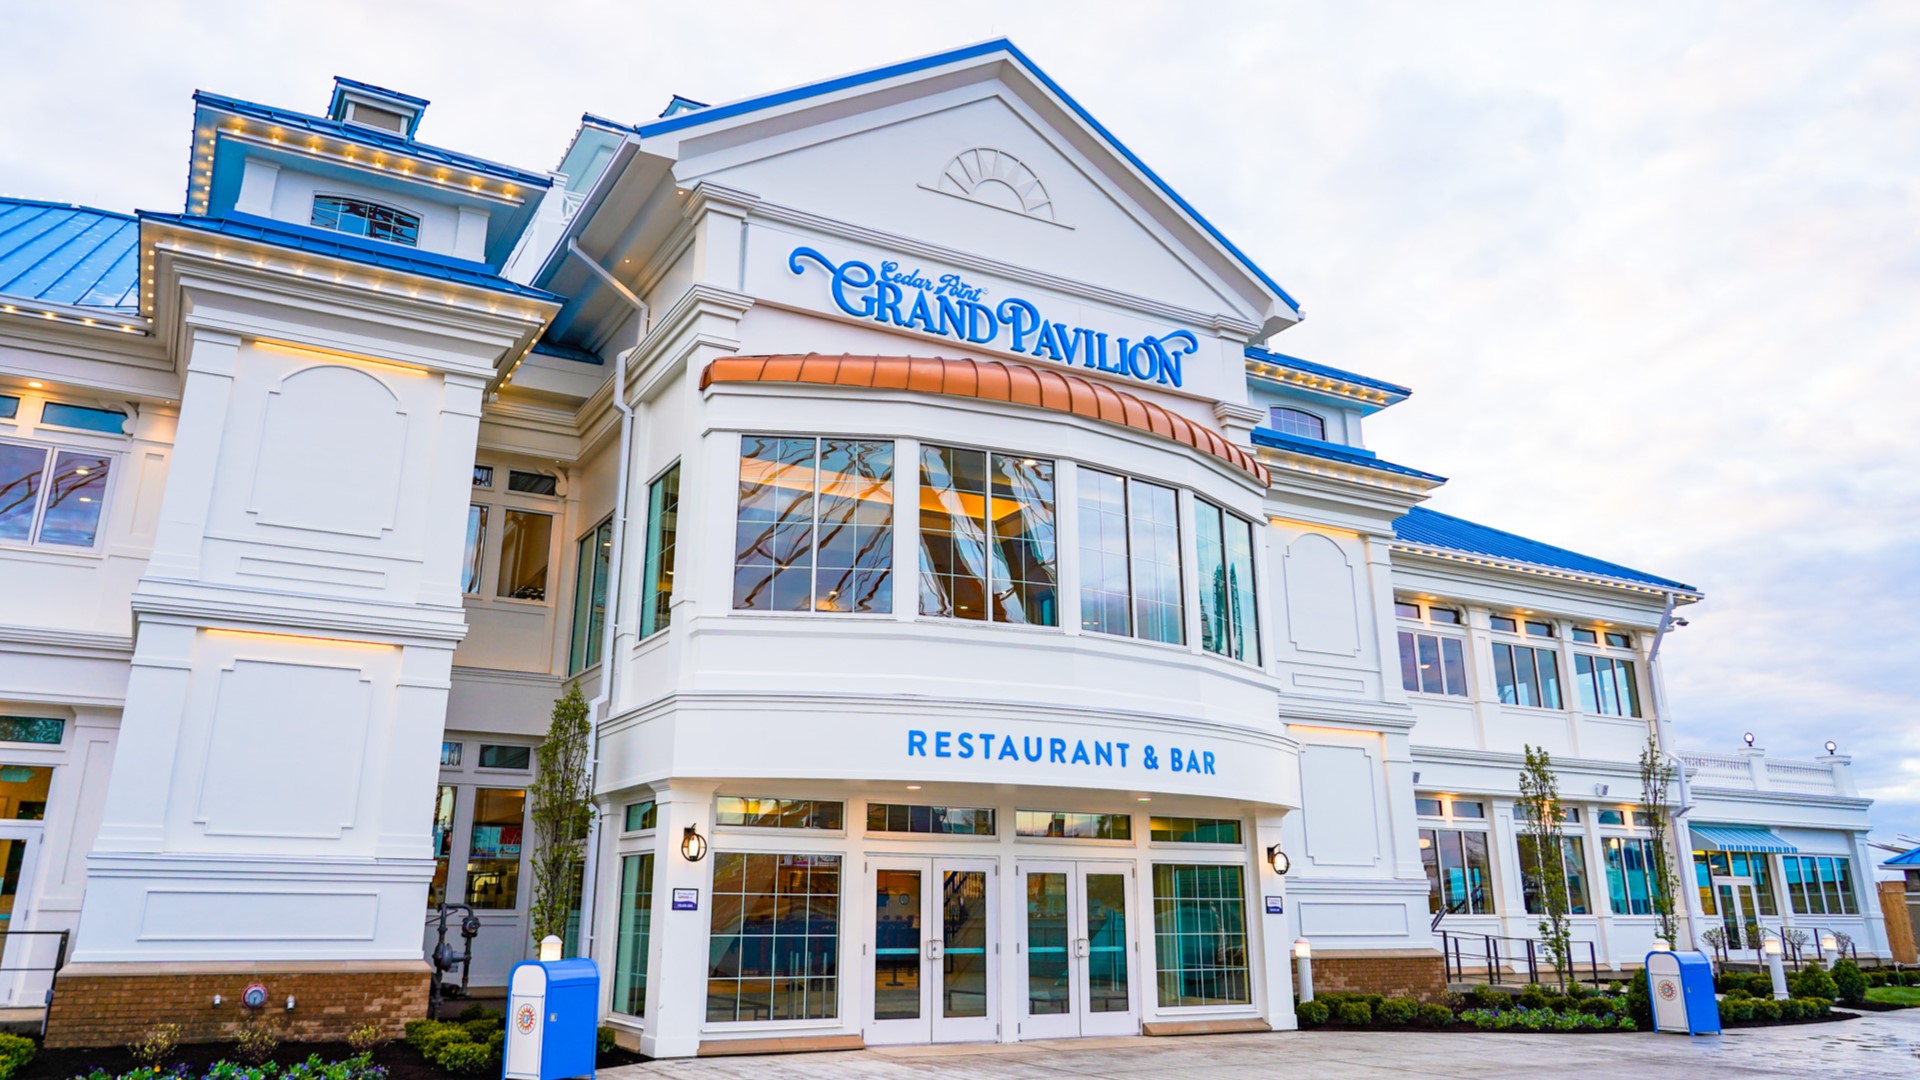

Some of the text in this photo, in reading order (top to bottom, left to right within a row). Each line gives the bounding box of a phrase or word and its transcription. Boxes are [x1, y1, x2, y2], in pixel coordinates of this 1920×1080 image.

[881, 261, 982, 302] Cedar Point
[789, 246, 1199, 388] GRAND PAVILION
[907, 729, 1217, 775] RESTAURANT & BAR
